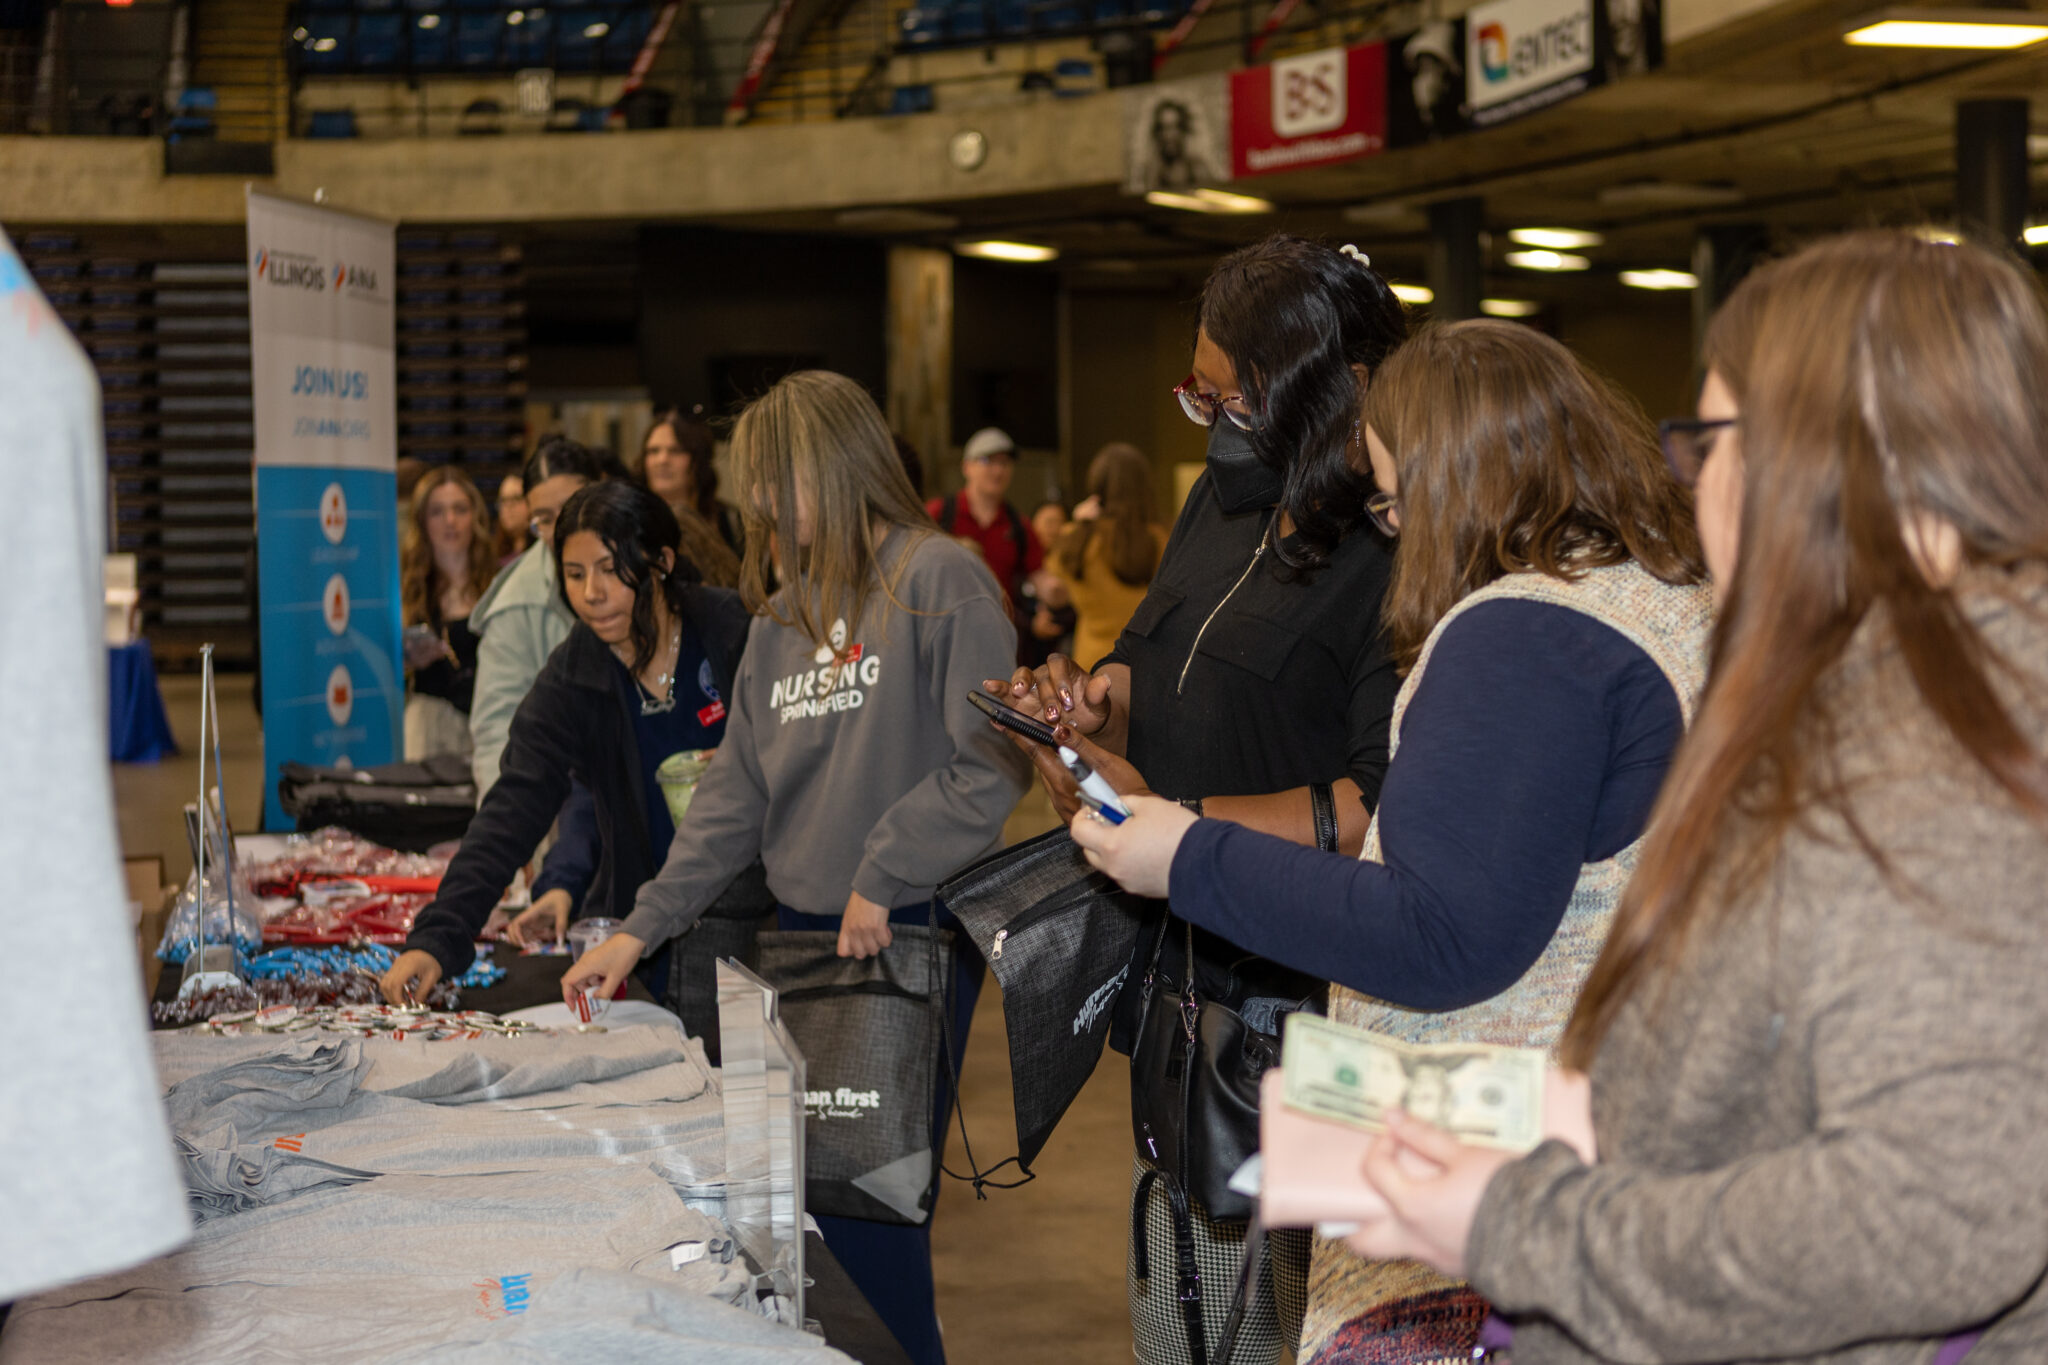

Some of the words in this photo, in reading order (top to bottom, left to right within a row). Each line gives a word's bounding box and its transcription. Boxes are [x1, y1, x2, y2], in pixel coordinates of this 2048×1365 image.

[269, 259, 326, 292] ILLINOIS
[292, 364, 336, 397] JOIN
[835, 1087, 880, 1108] first
